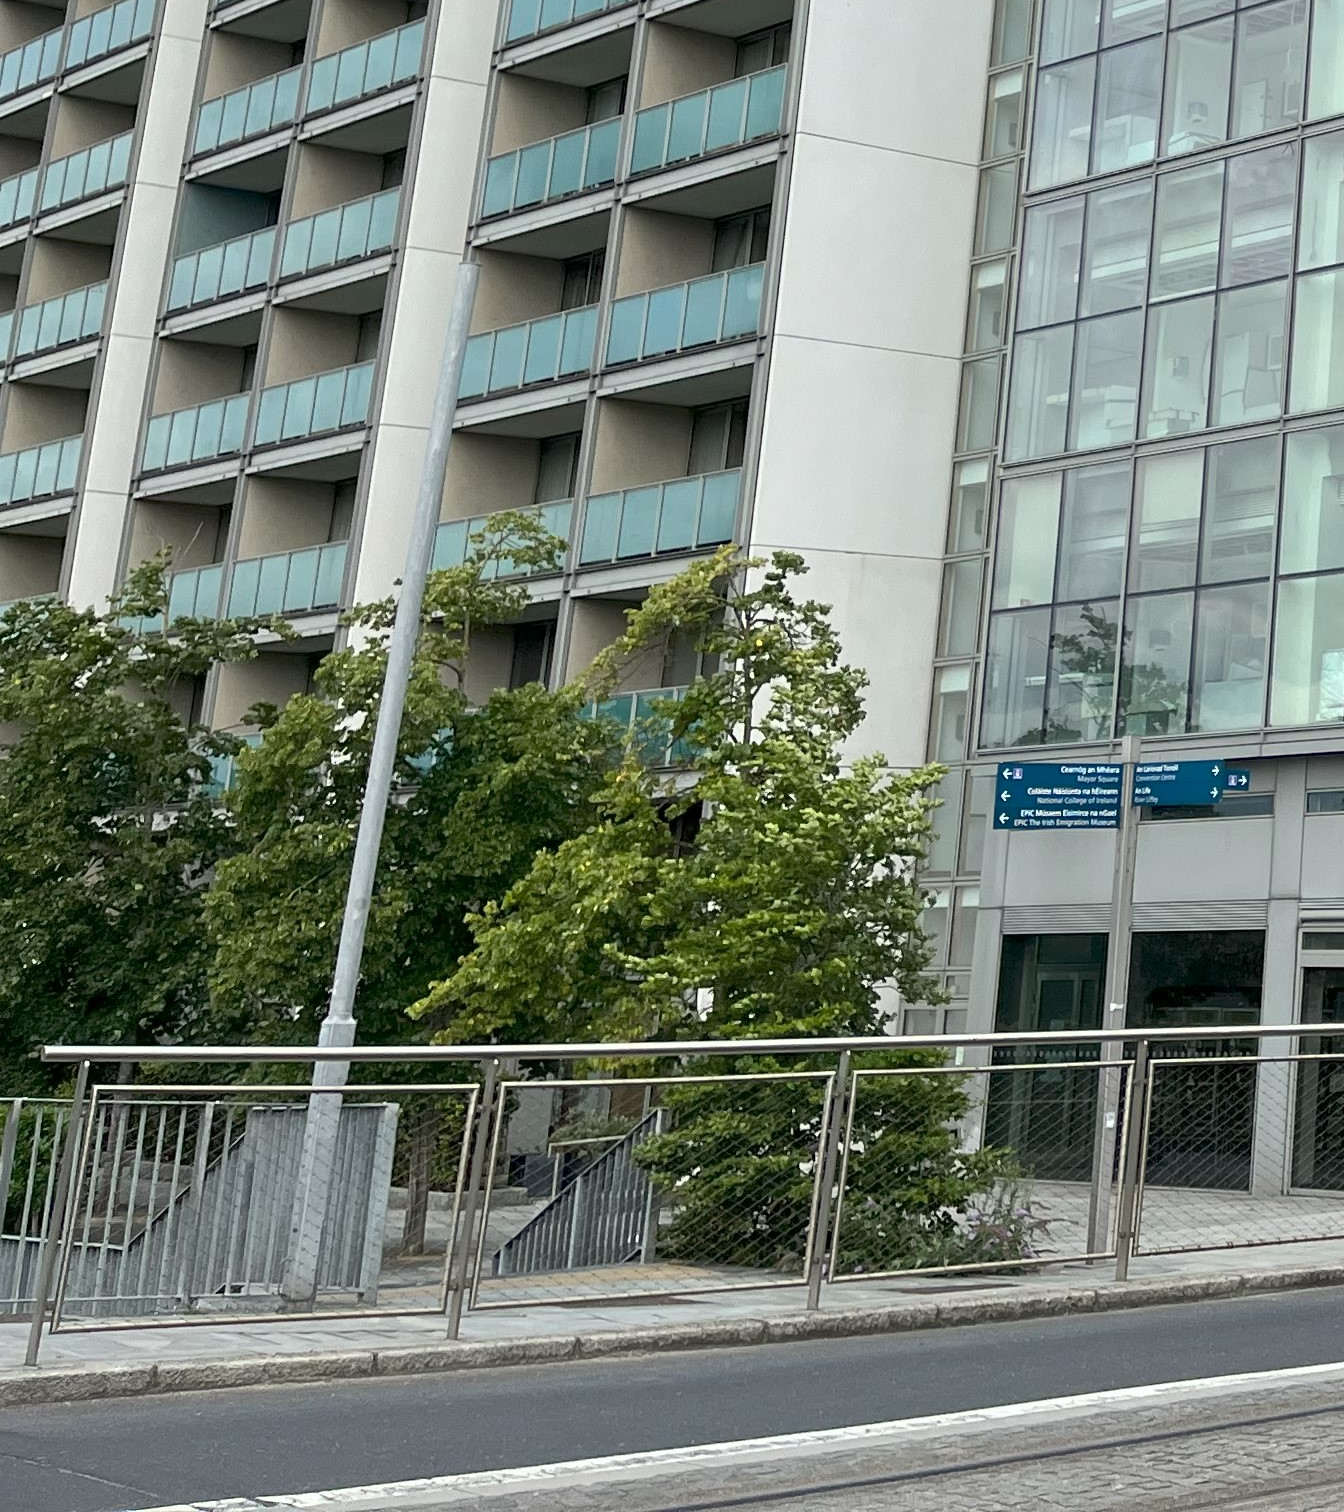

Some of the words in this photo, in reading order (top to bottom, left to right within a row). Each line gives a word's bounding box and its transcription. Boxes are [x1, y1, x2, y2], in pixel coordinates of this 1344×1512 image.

[1077, 775, 1097, 784] Mayor
[1097, 775, 1119, 784] Square
[1064, 797, 1088, 806] College
[1020, 809, 1035, 817] EPIC
[1055, 819, 1090, 827] Emigration
